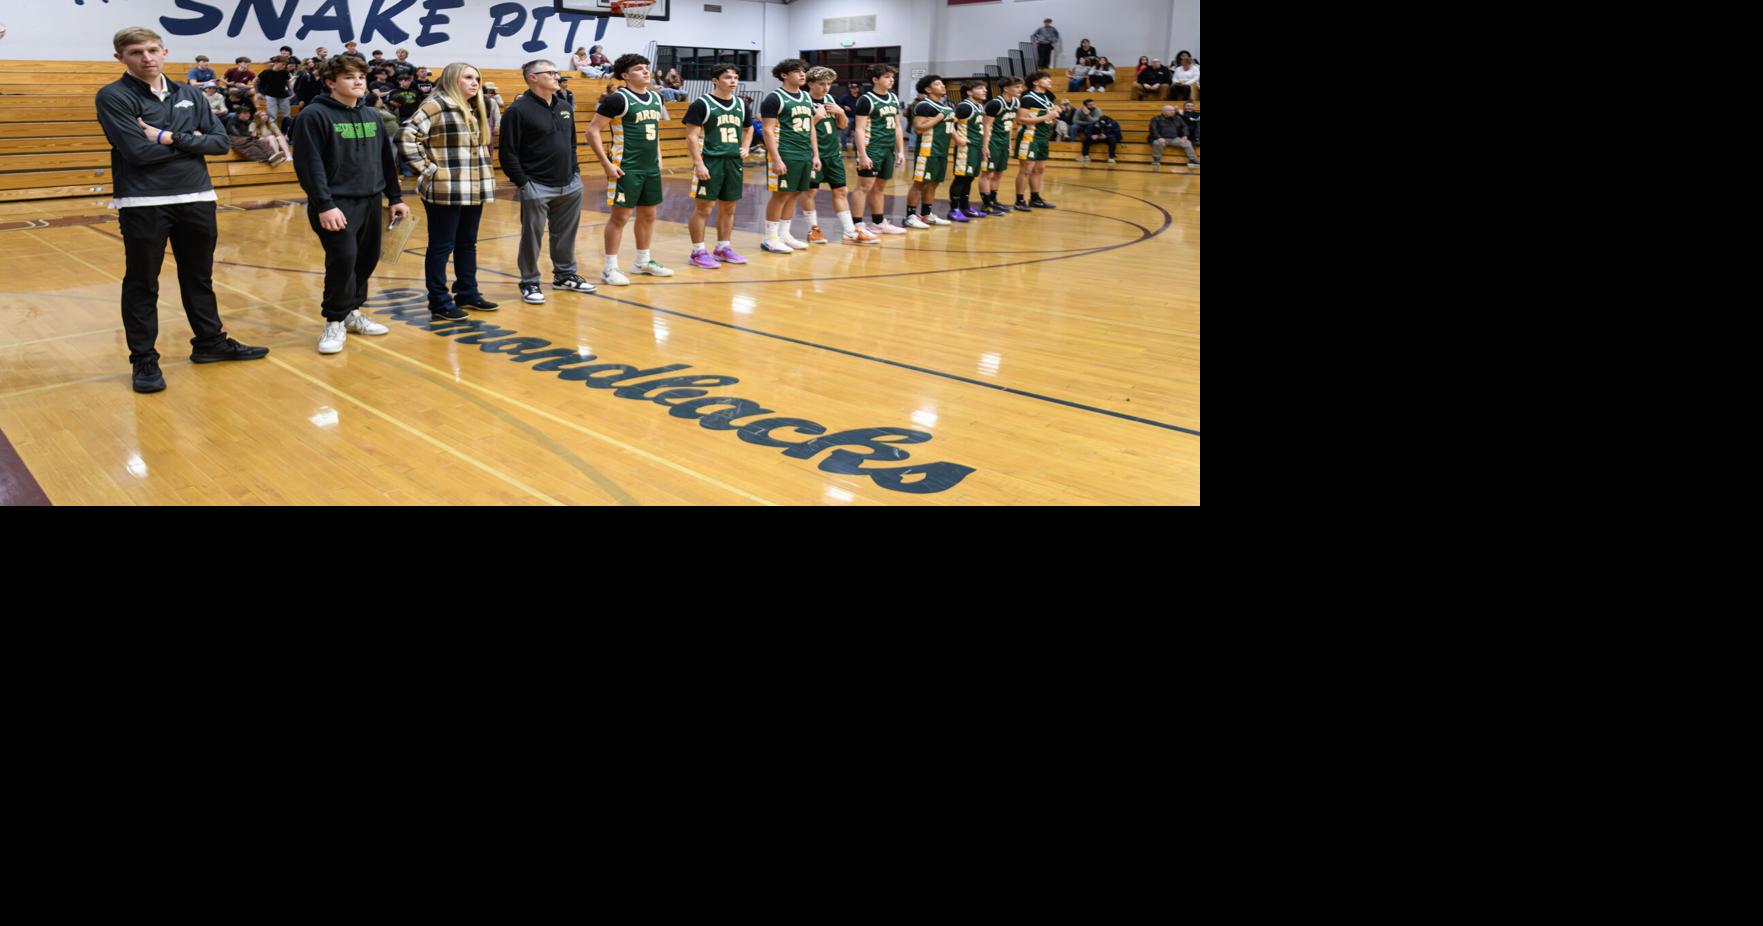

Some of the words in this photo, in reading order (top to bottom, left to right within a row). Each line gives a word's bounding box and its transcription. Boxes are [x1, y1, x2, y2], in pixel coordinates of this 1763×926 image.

[160, 0, 465, 47] SNAKE
[645, 123, 656, 141] 5
[792, 117, 811, 132] 24
[719, 127, 738, 144] 12
